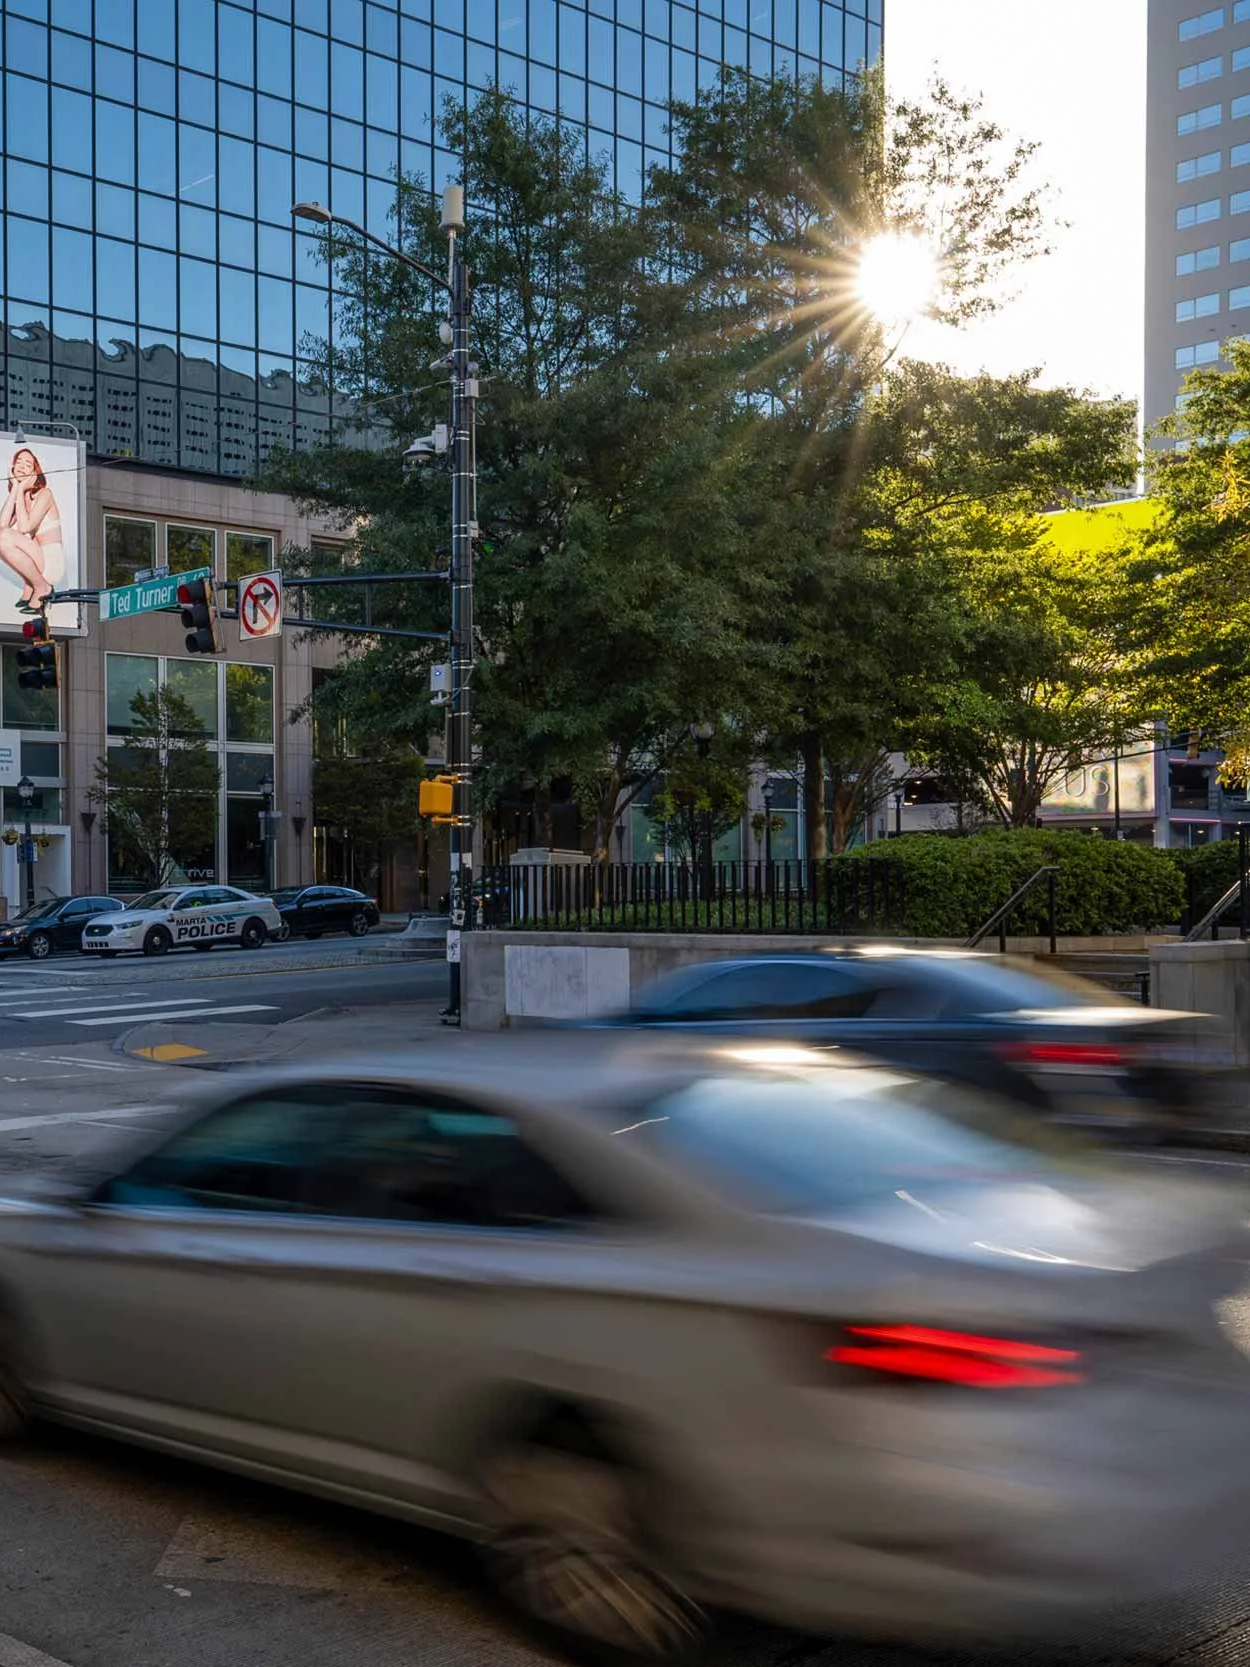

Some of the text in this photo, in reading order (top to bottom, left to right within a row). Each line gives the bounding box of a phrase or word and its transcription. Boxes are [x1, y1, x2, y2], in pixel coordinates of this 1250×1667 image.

[111, 592, 130, 614] Ted
[135, 585, 174, 609] Turner
[176, 917, 206, 926] MARTA
[178, 922, 236, 939] POLICE
